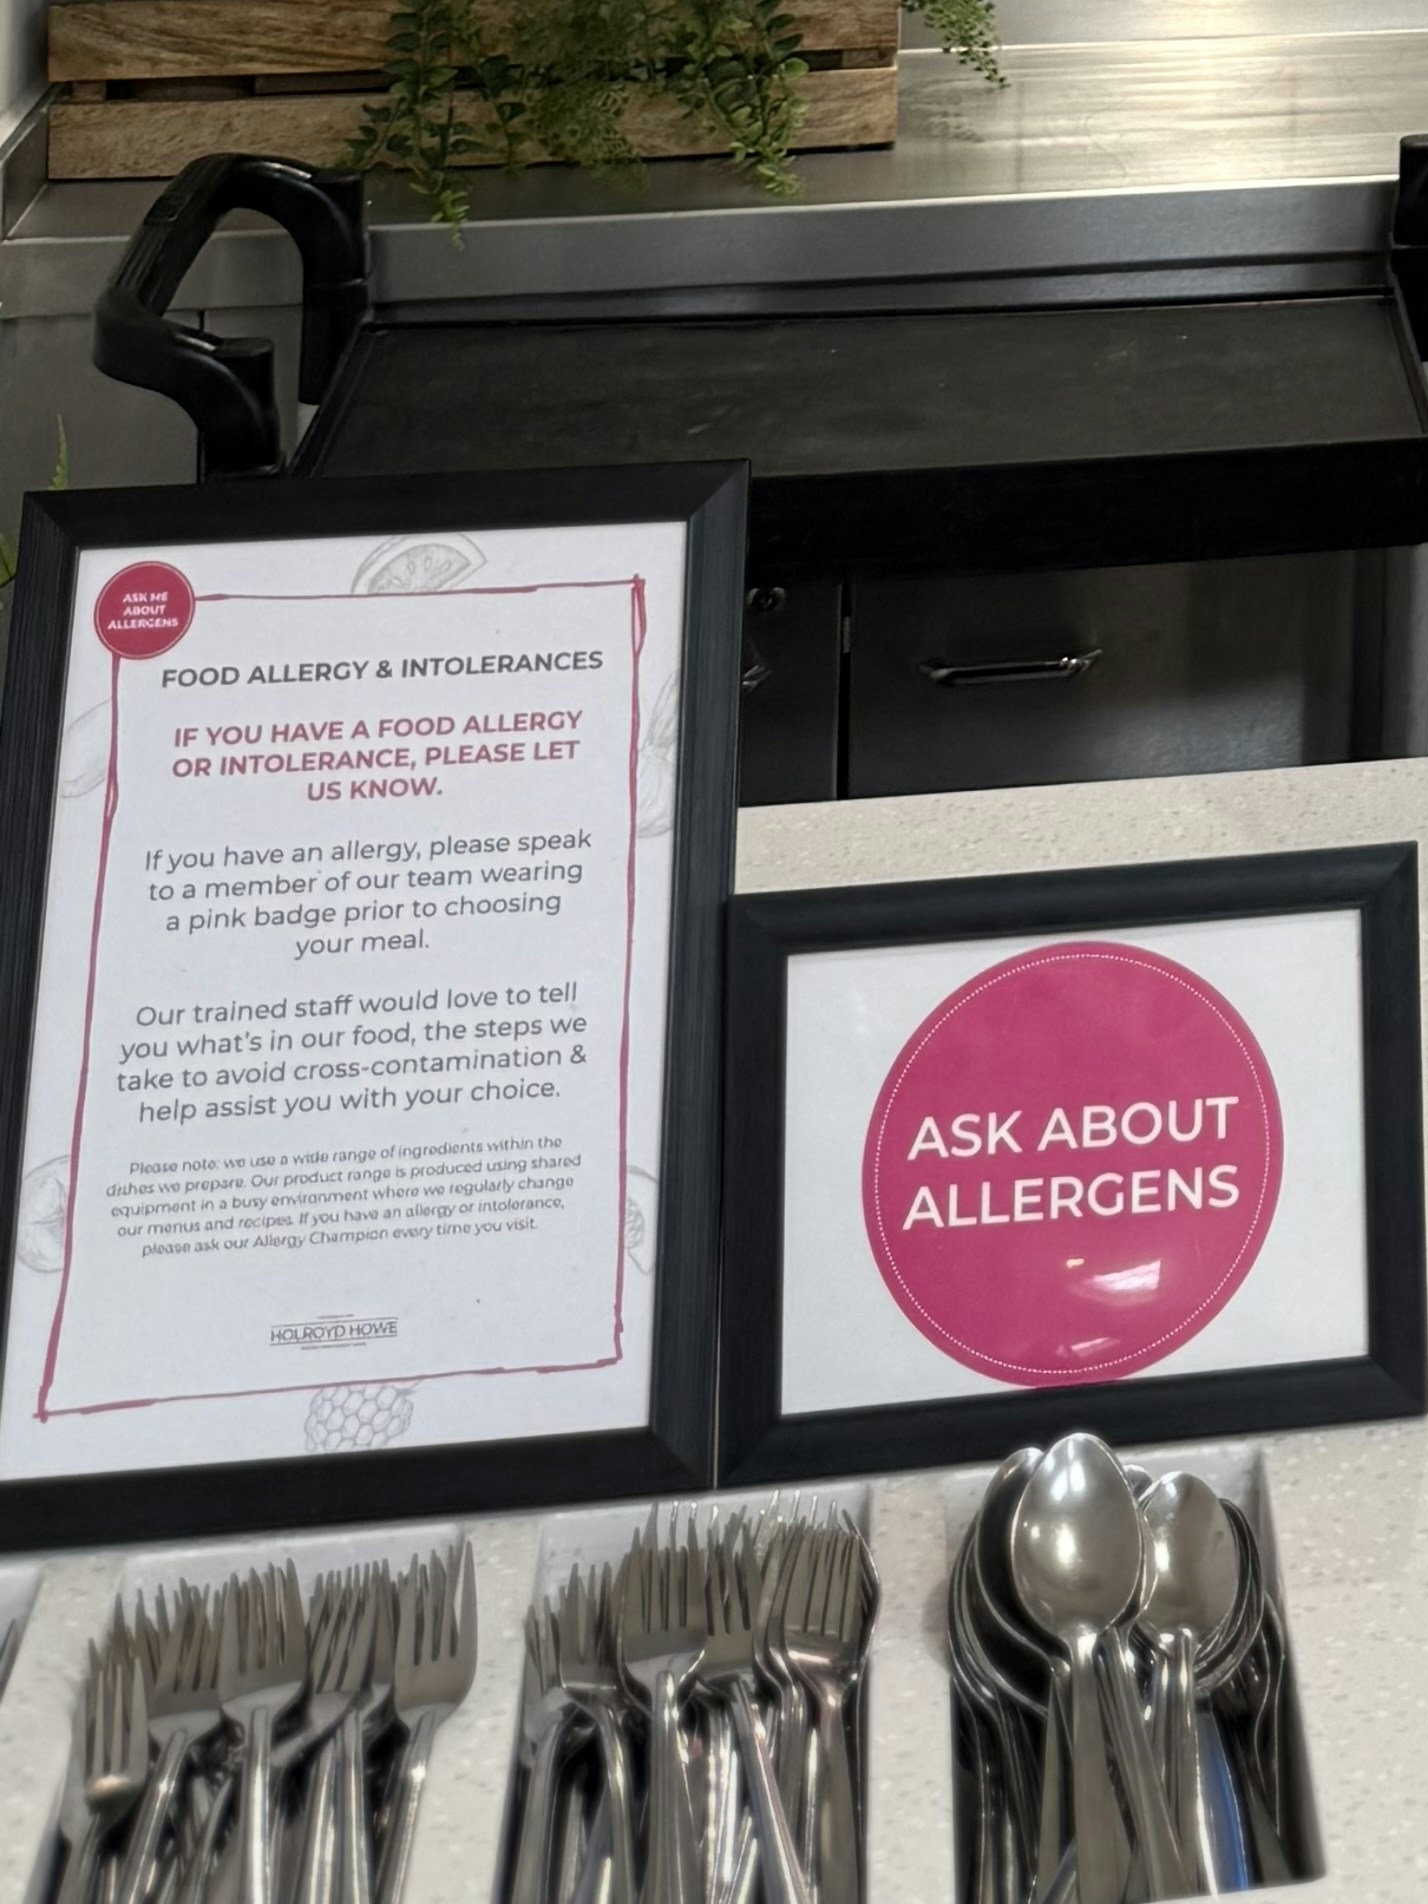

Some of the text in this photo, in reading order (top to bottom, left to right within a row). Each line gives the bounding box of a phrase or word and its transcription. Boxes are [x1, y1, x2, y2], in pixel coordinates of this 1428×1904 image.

[122, 591, 169, 604] ASK ME
[123, 604, 166, 616] ABOUT
[106, 617, 179, 630] ALLERGENS
[162, 650, 603, 688] FOOD ALLERGY & INTOLERANCES
[175, 709, 582, 748] IF YOU HAVE A FOOD ALLERGY
[172, 740, 580, 778] OR INTOLERANCE, PLEASE LET
[308, 777, 442, 802] US KNOW.
[146, 829, 591, 875] If you have an allergy, please speak
[149, 862, 582, 901] to a member of our team wearing
[166, 894, 561, 936] a pink badge prior to choosing
[294, 928, 429, 961] your meal.
[136, 981, 576, 1027] Our trained staff would love to tell
[119, 1017, 587, 1065] you what's in our food, the steps we
[117, 1044, 586, 1092] take to avoid cross-contamination &
[140, 1077, 560, 1126] help assist you with your choice.
[908, 1096, 1239, 1160] ASK ABOUT
[903, 1164, 1239, 1230] ALLERGENS
[270, 1321, 398, 1342] HOLROYD HOWE
